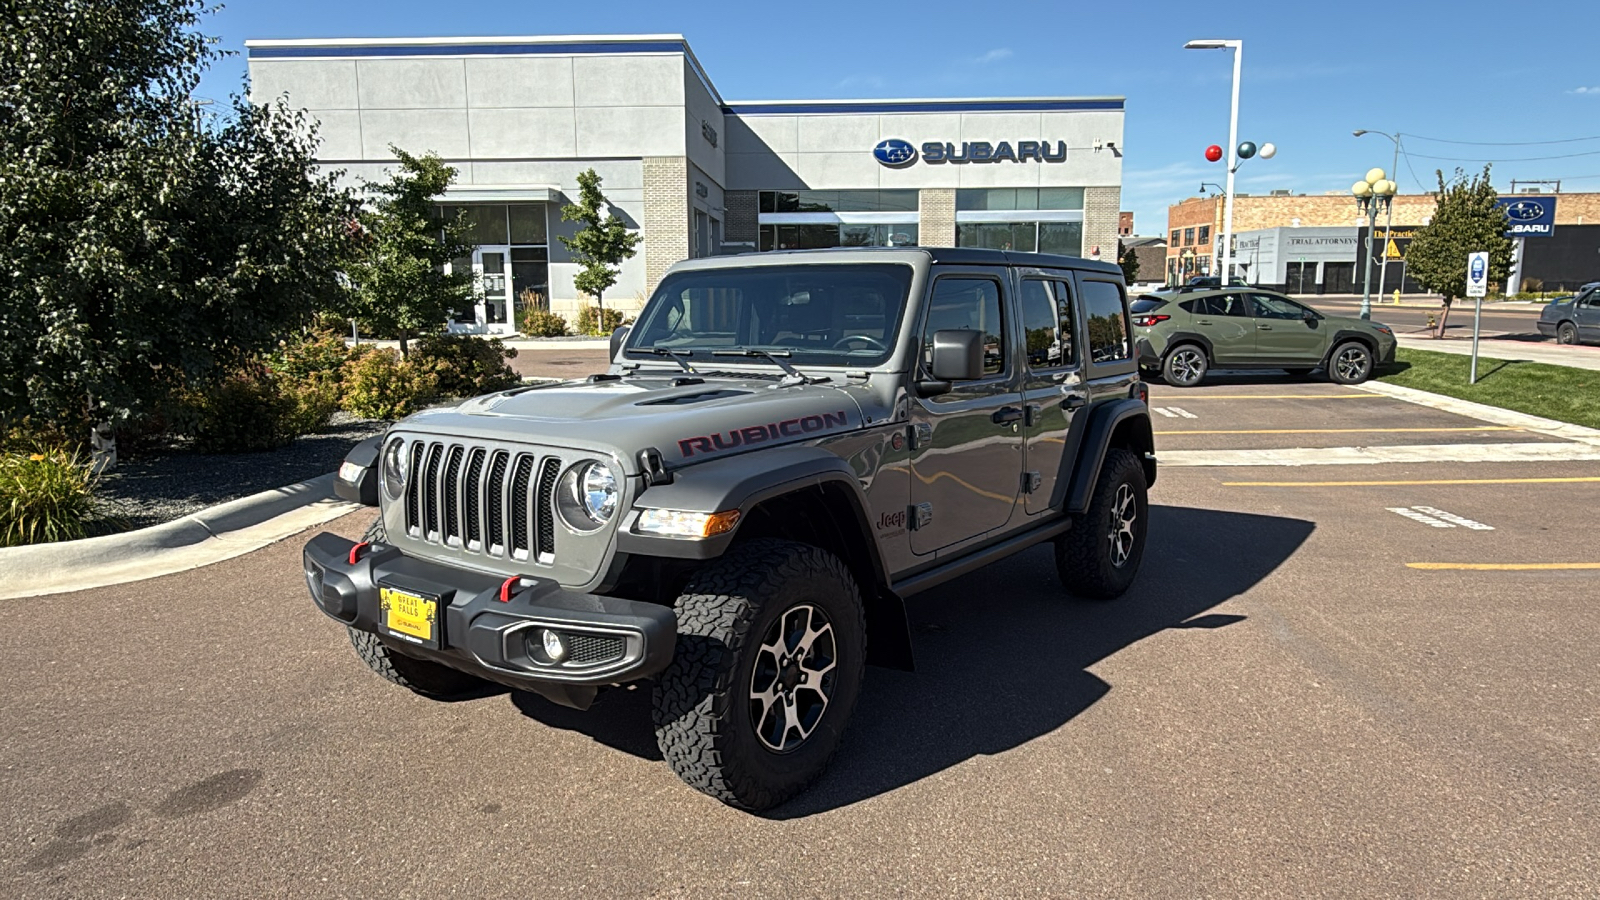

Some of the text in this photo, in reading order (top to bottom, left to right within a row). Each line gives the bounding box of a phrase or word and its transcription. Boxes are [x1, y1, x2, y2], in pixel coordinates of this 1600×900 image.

[921, 140, 1067, 165] SUBARU
[1389, 229, 1415, 238] Practic
[1506, 224, 1550, 233] BARU
[677, 411, 848, 458] RUBICON
[876, 511, 905, 530] Jeep
[397, 595, 418, 607] GREAT
[398, 603, 419, 617] FALLS
